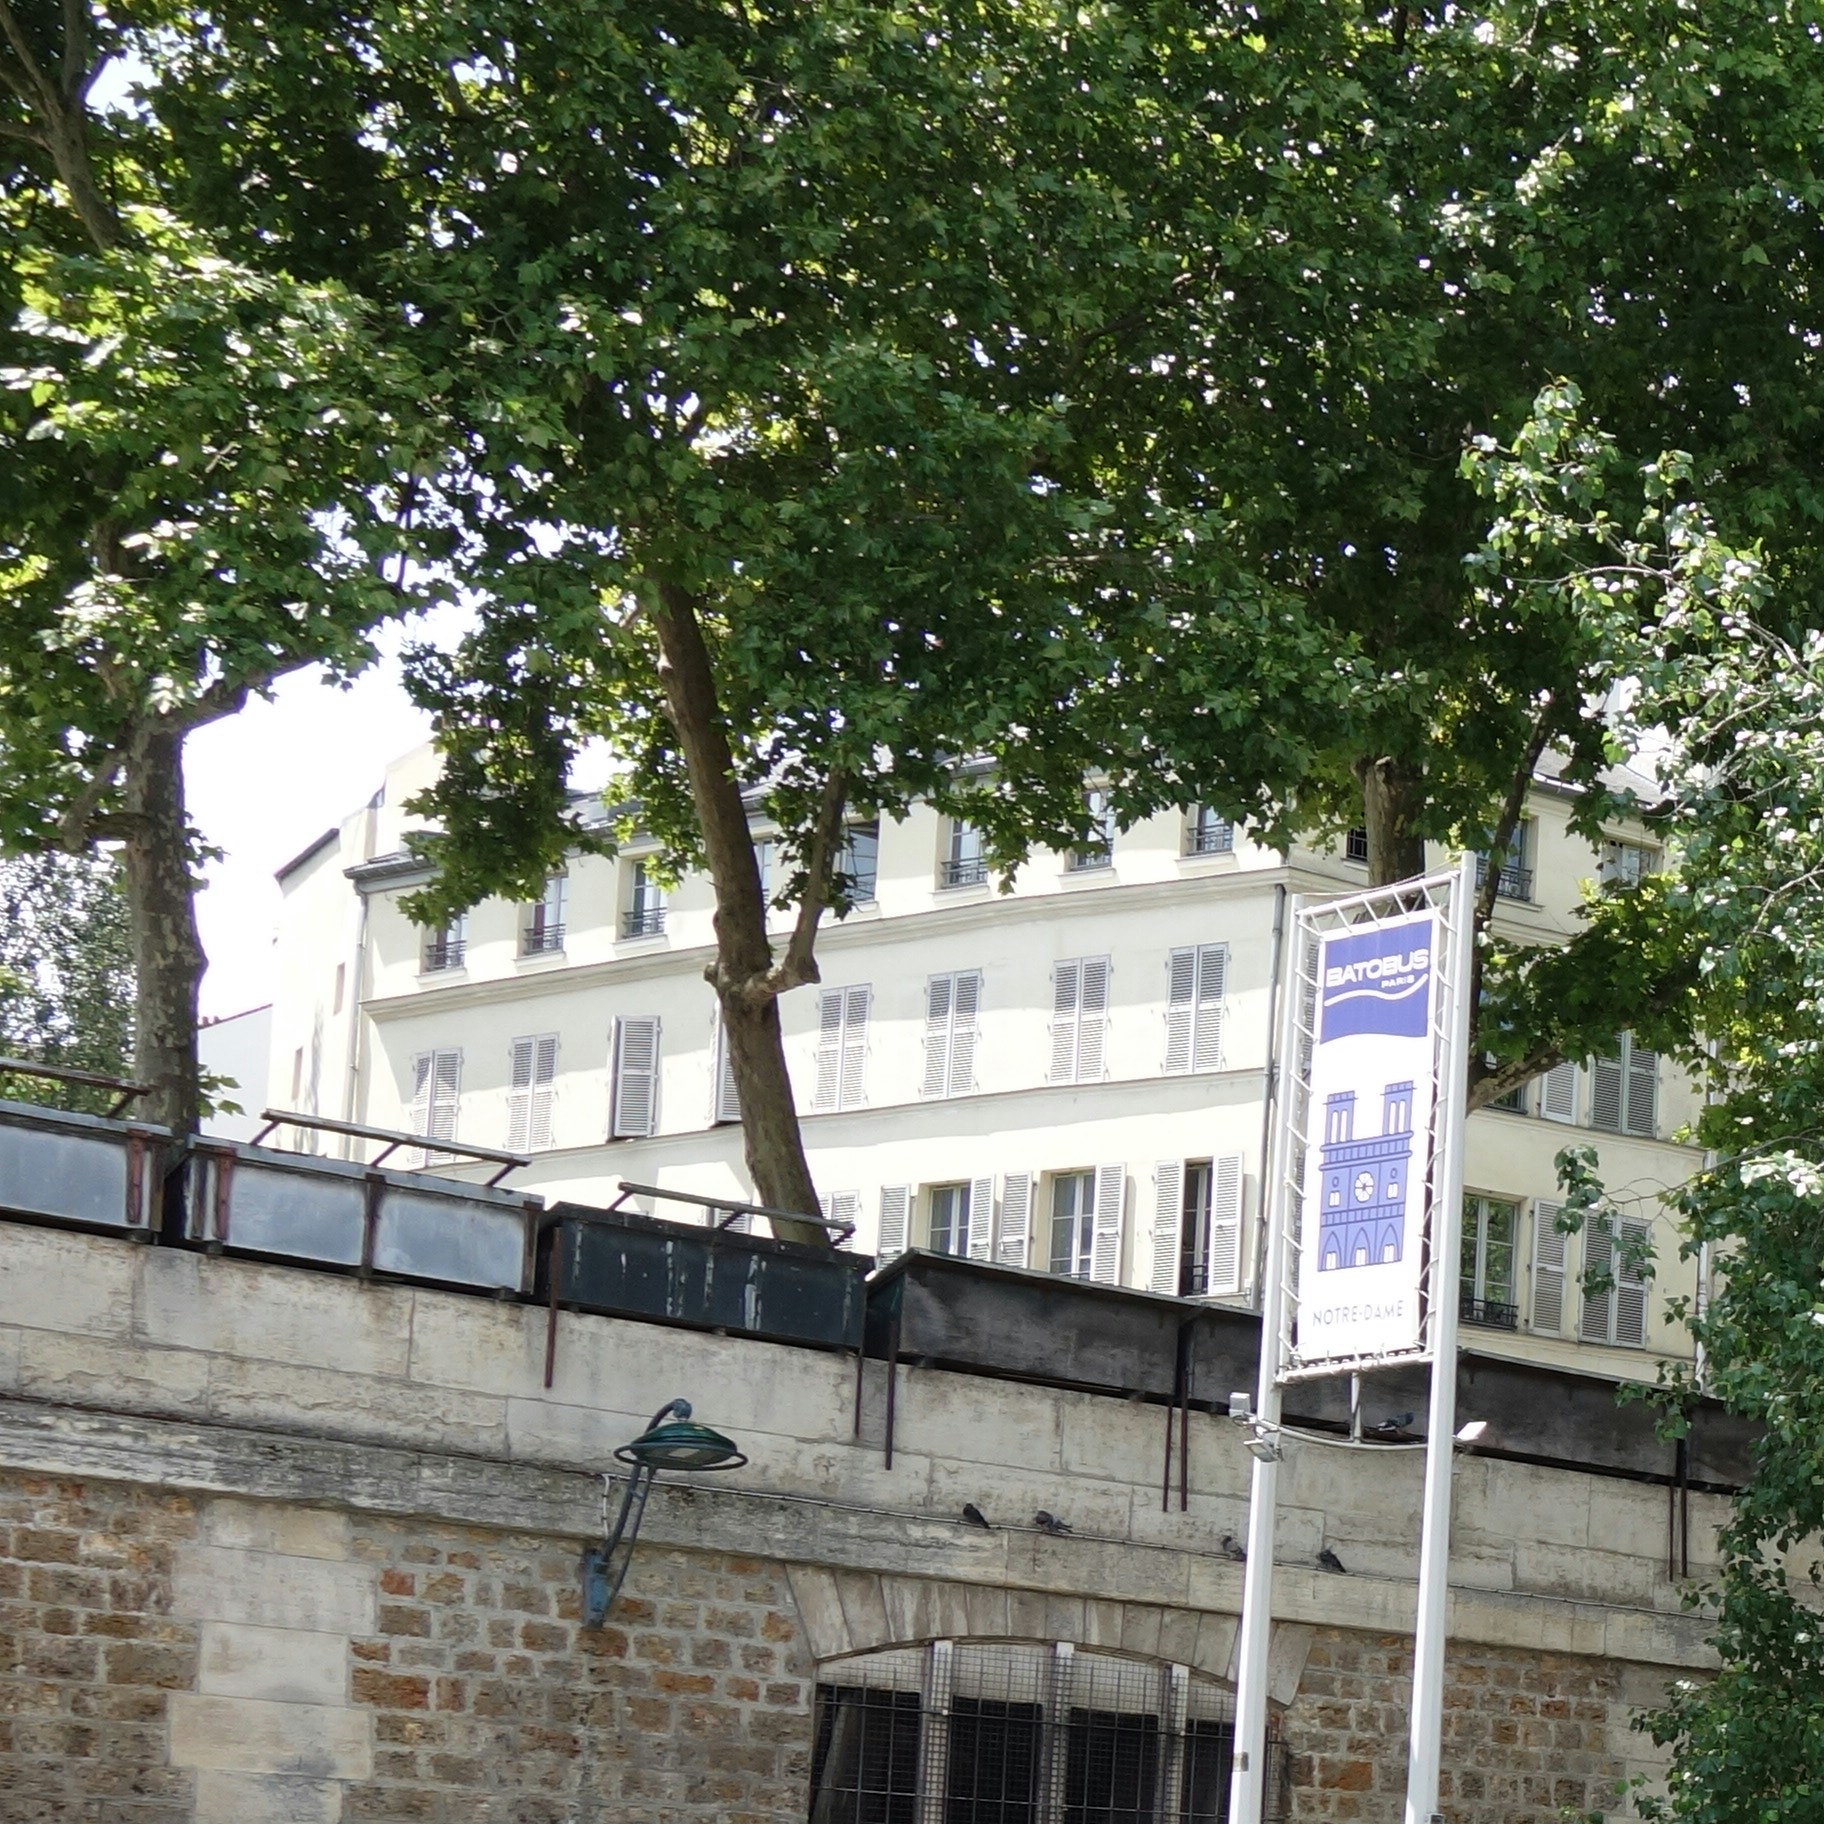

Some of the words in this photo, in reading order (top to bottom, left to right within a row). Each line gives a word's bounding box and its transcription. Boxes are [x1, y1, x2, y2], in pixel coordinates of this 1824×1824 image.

[1326, 948, 1429, 988] BATOBUS
[1381, 974, 1415, 988] PARIS
[1312, 1299, 1404, 1327] NOTRE-DAME
